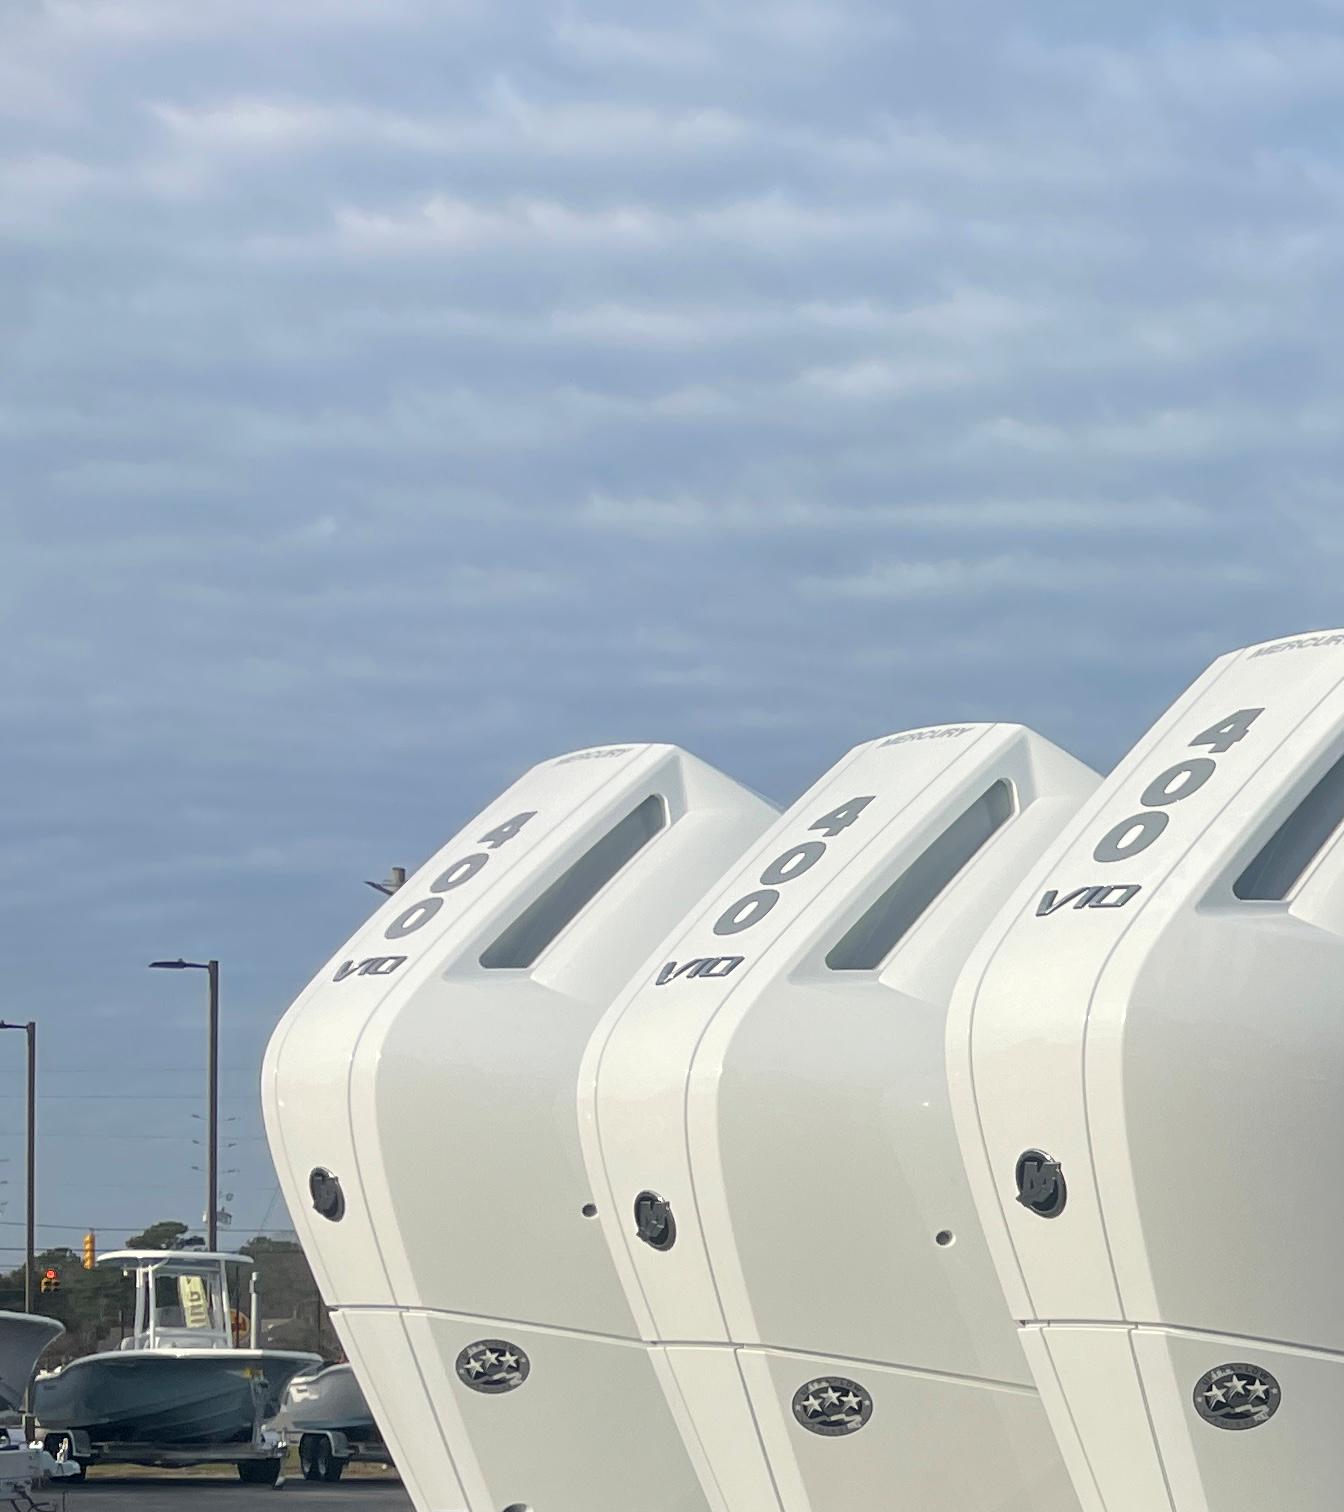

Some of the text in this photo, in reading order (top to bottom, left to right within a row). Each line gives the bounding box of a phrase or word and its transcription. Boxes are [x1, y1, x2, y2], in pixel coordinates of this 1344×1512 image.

[1093, 707, 1266, 863] 400
[384, 811, 538, 940] 400
[713, 795, 877, 936] 400
[1036, 884, 1142, 917] V10
